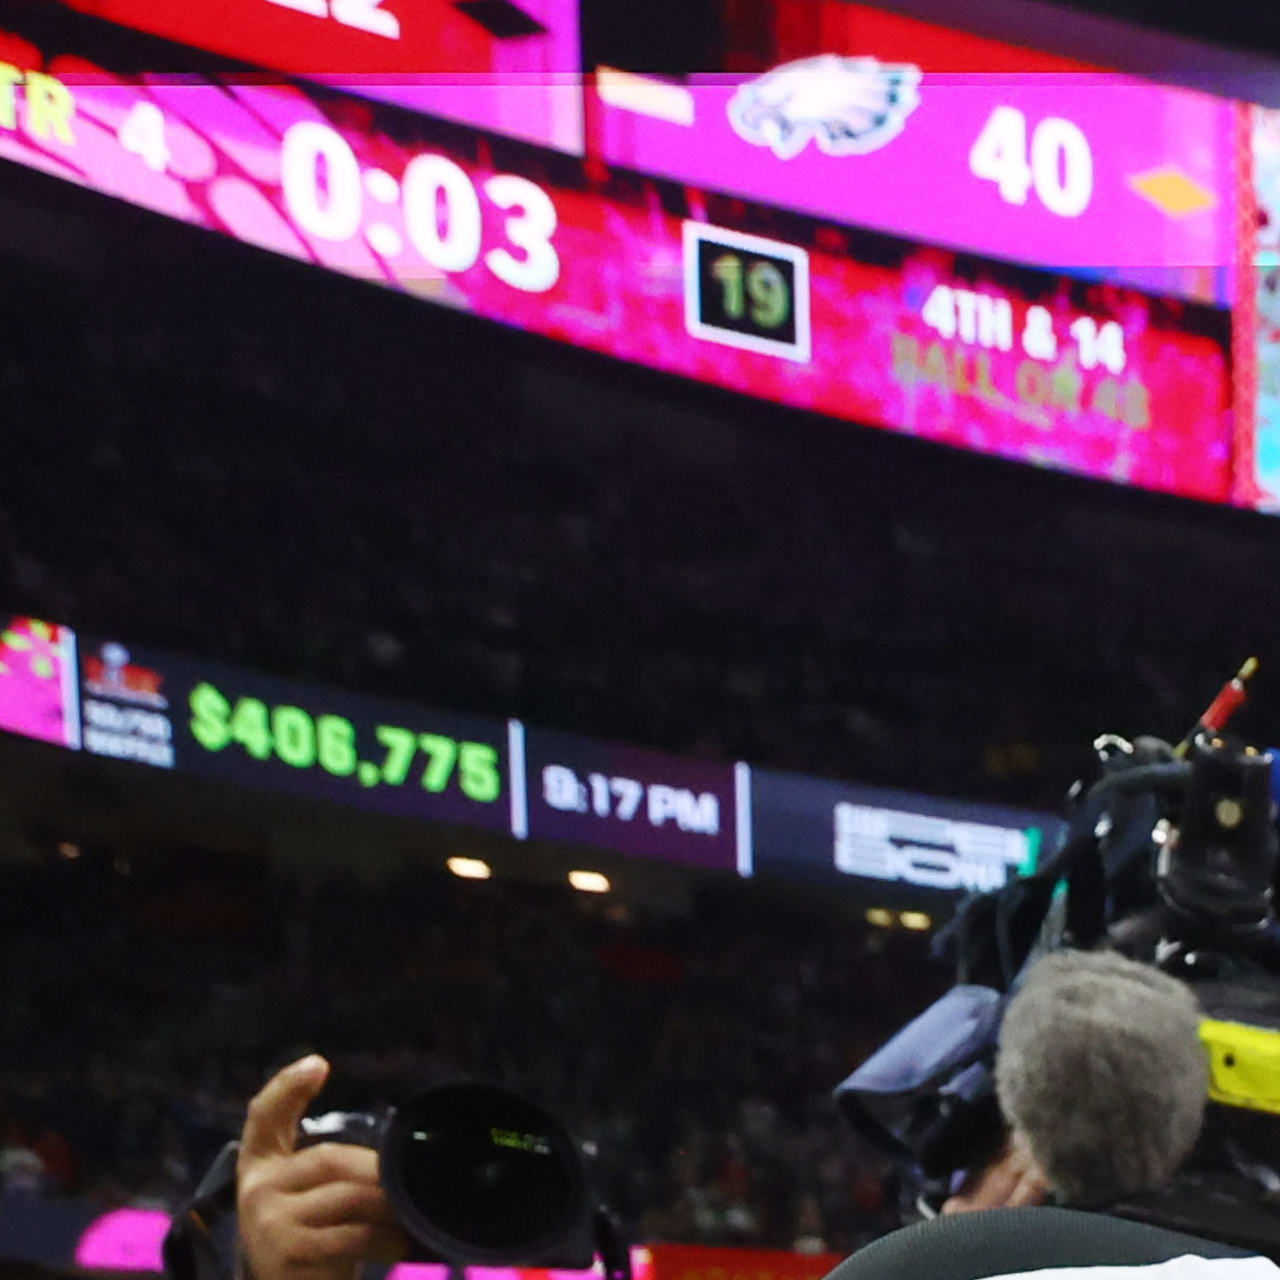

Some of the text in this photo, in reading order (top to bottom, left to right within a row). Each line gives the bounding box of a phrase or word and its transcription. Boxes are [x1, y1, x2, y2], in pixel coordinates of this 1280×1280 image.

[0, 60, 561, 294] TR 4 0:03
[969, 105, 1094, 218] 40
[711, 252, 791, 329] 19
[922, 284, 1013, 352] 4TH
[188, 681, 501, 802] $406,775
[646, 784, 721, 836] PM
